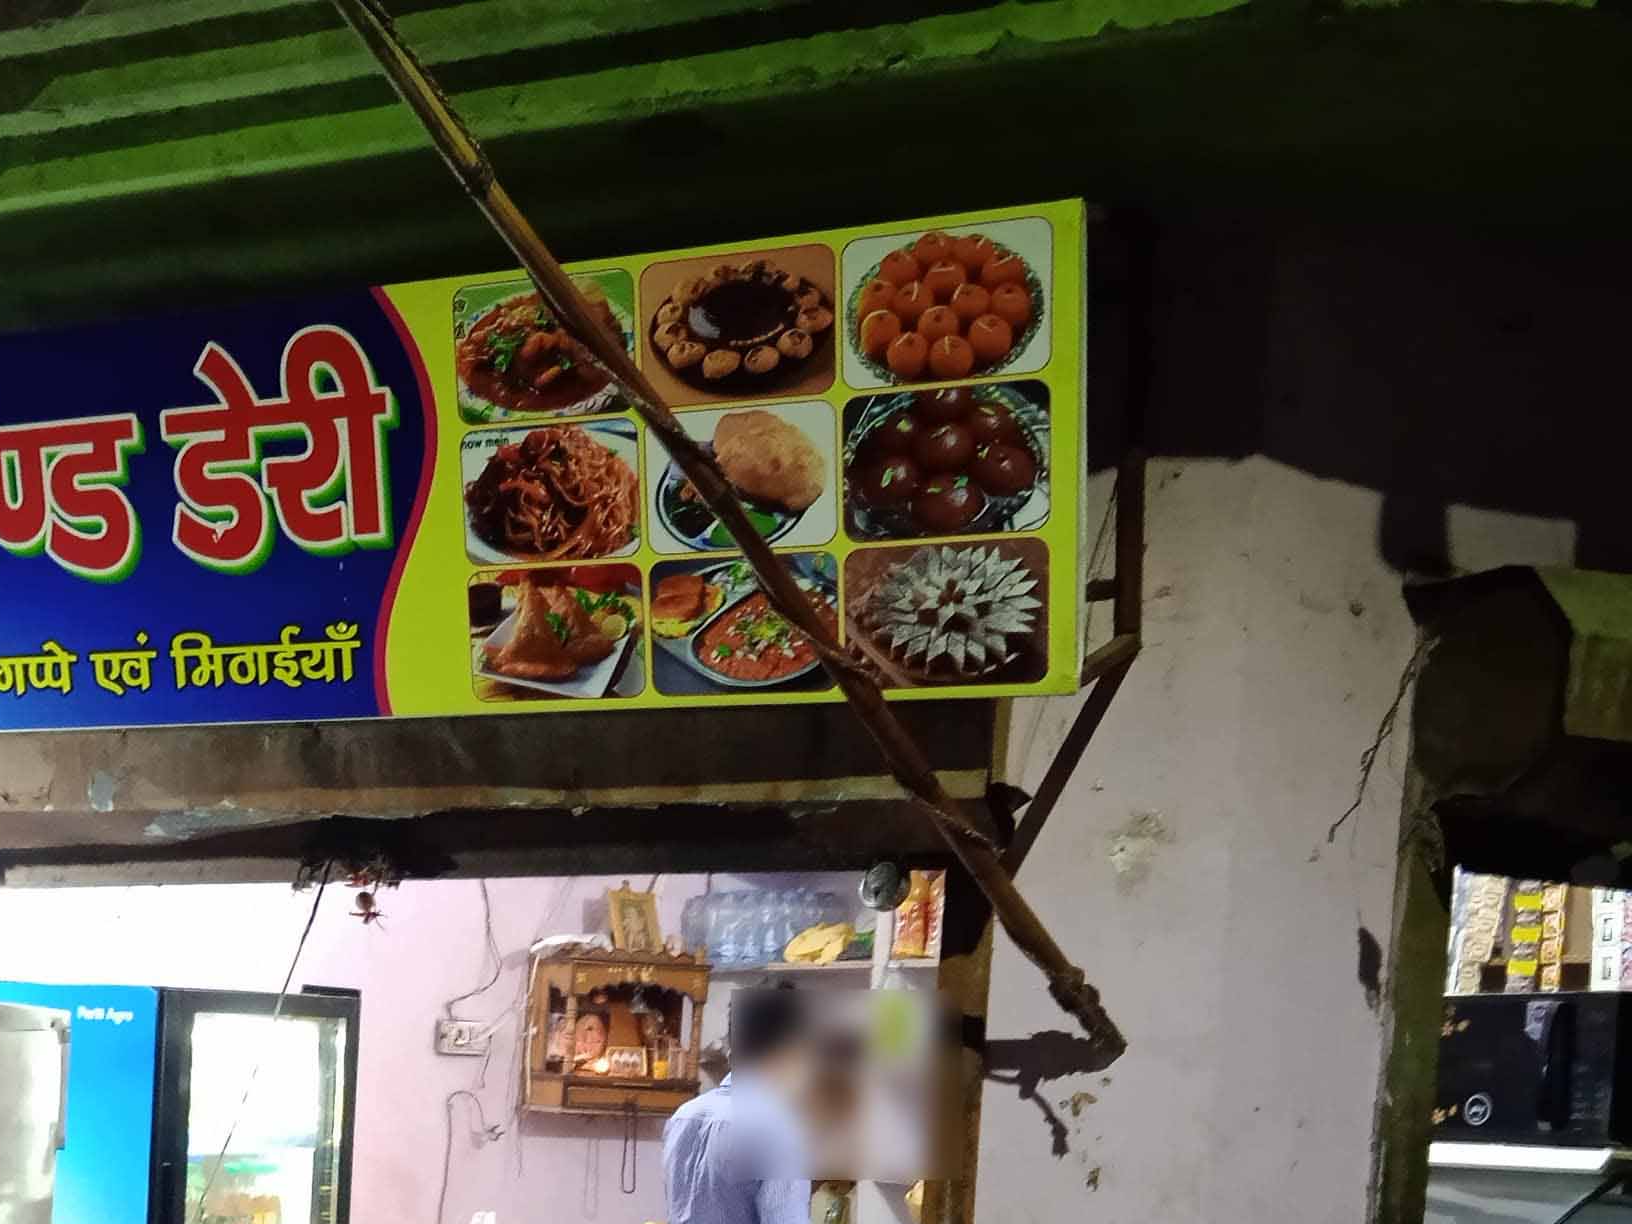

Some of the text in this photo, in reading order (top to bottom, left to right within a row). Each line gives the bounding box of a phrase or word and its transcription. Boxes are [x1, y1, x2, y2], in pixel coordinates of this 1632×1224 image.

[164, 323, 394, 571] डेरी
[88, 630, 158, 697] एवं
[168, 621, 363, 690] मिठाईयाँ
